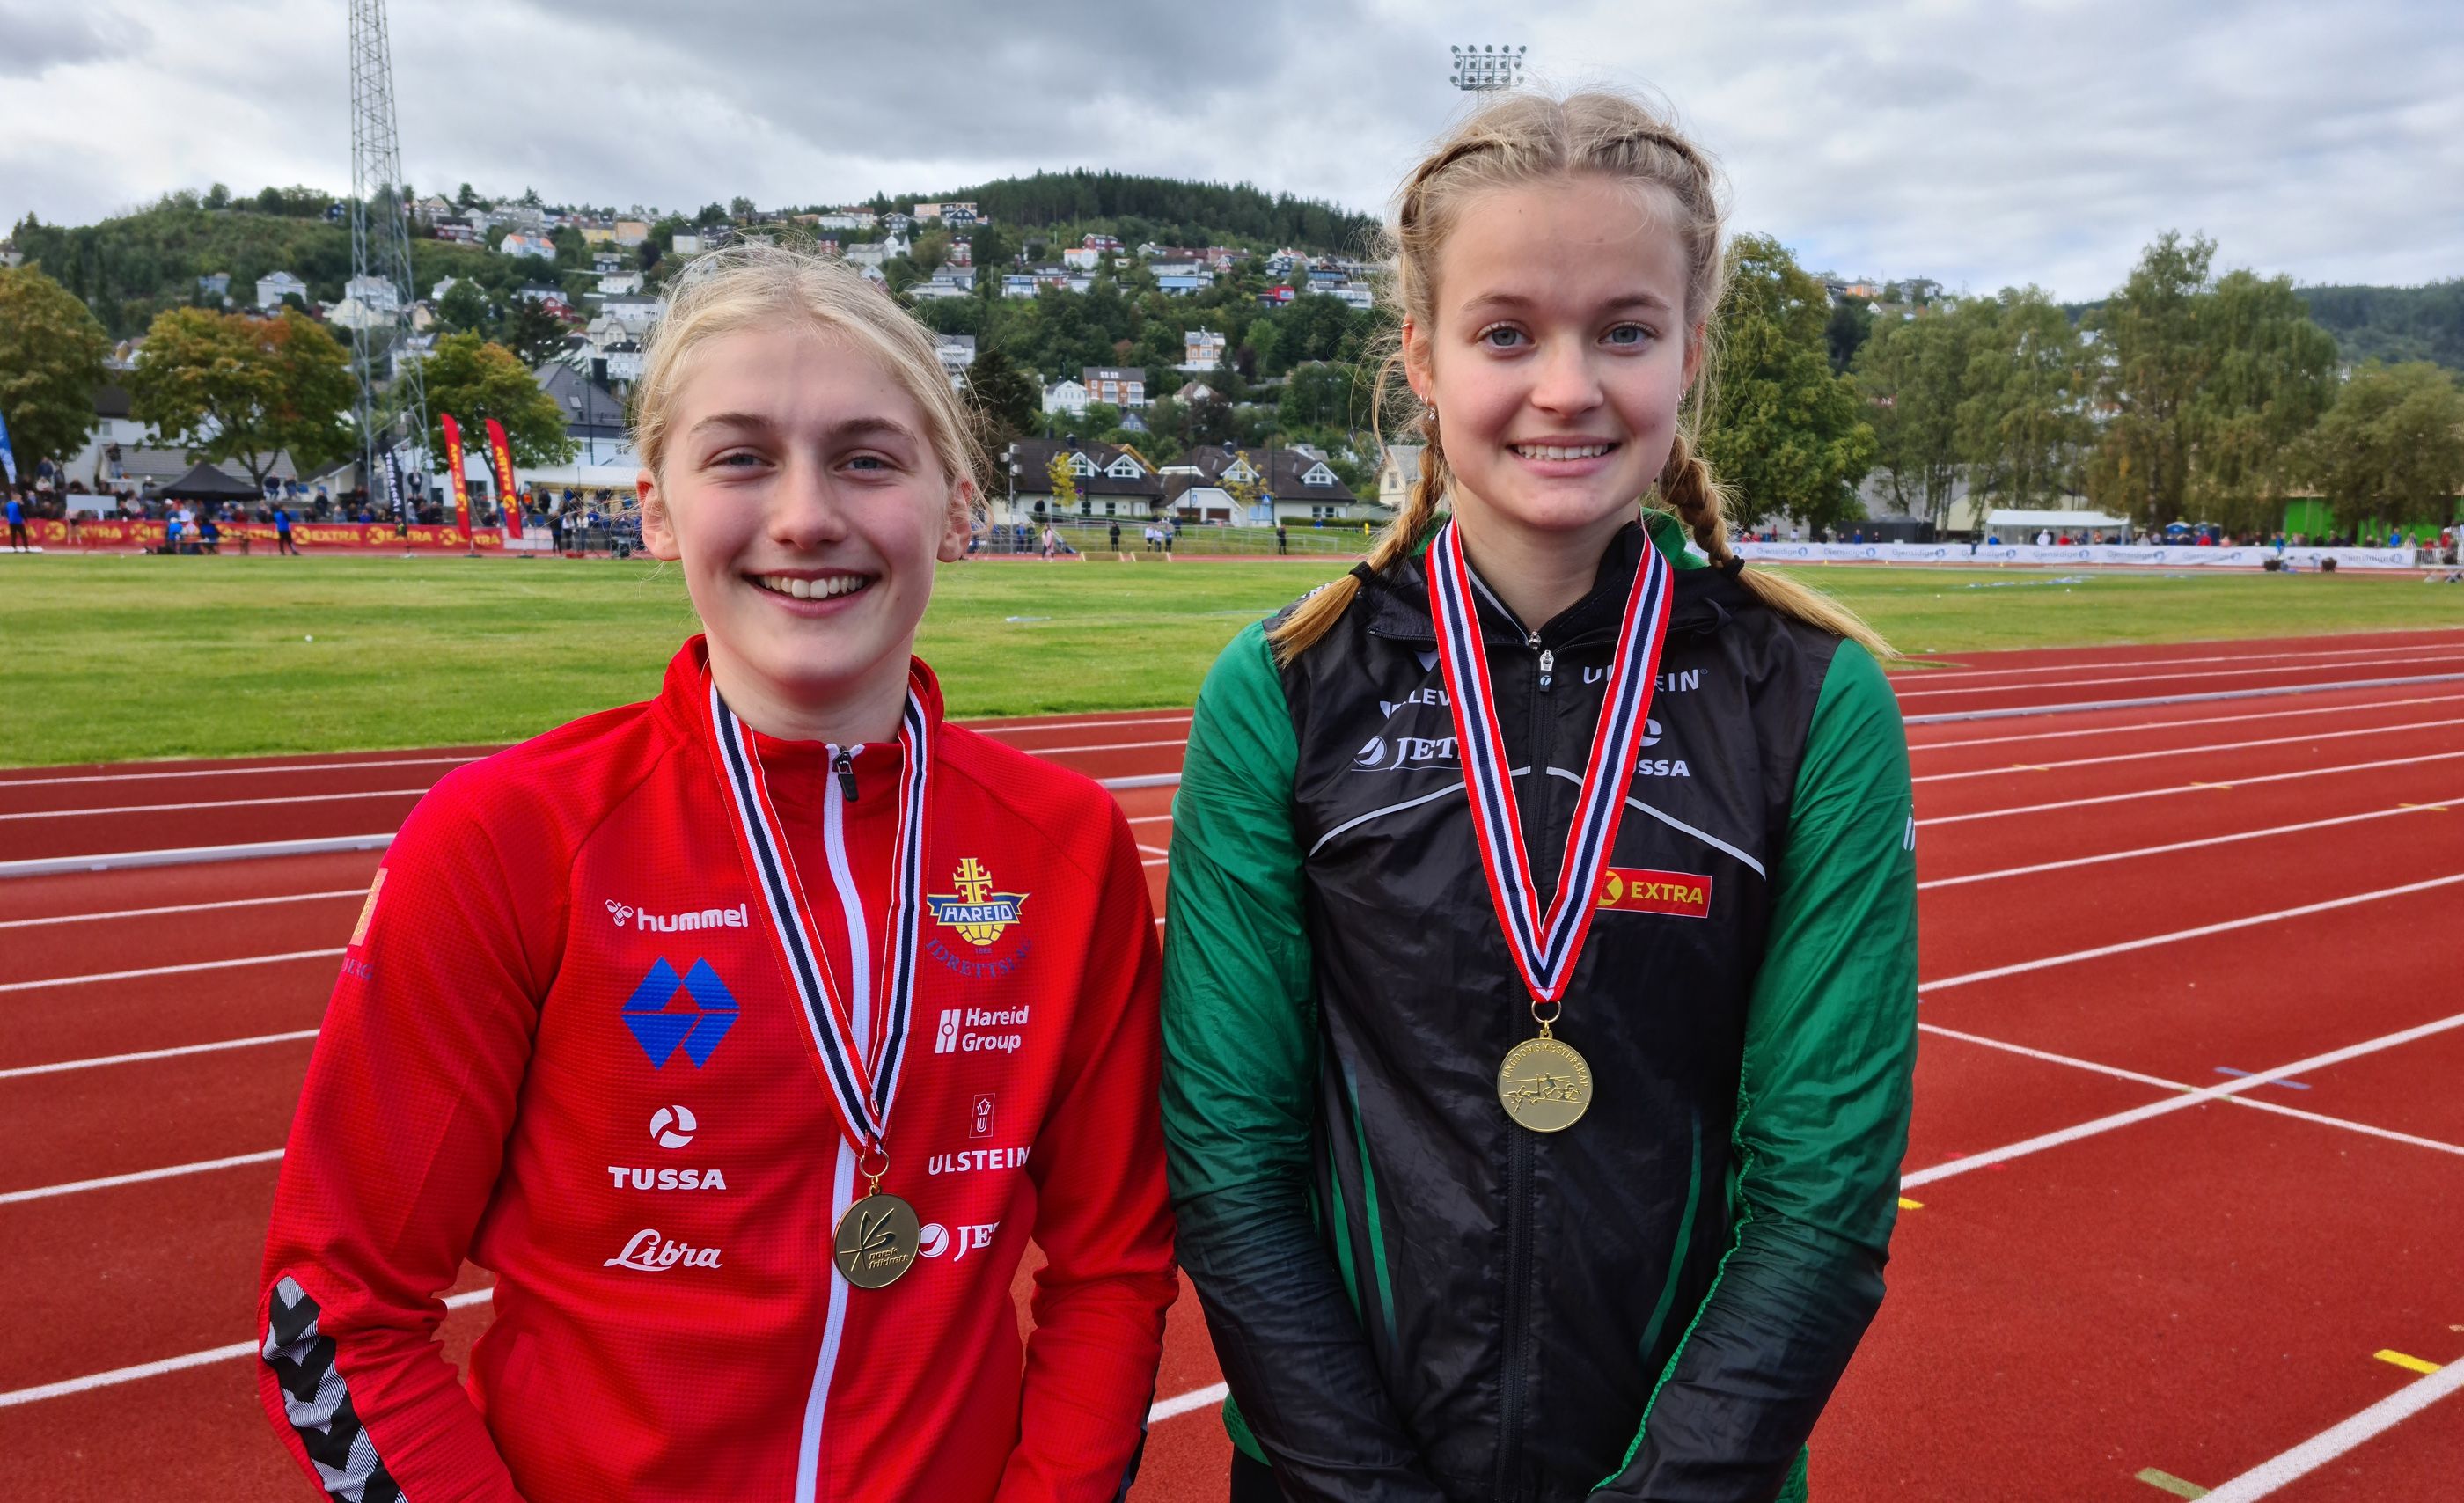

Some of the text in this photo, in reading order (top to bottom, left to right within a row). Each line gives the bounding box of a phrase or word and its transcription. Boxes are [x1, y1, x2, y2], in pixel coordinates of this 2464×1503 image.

[312, 530, 361, 541] EXTRA
[385, 530, 433, 542] ETRA
[1634, 759, 1690, 777] SSA
[1631, 881, 1704, 905] EXTRA
[637, 903, 748, 933] hummel
[943, 905, 1014, 922] HAREID
[965, 1005, 1030, 1027] Hareid
[962, 1032, 1022, 1054] Group
[1502, 1043, 1588, 1087] UNGDOMSMESTERSKAP
[928, 1146, 1030, 1175] ULSTEIN
[608, 1166, 727, 1190] TUSSA
[603, 1228, 723, 1272] Libra
[869, 1247, 898, 1260] norsk
